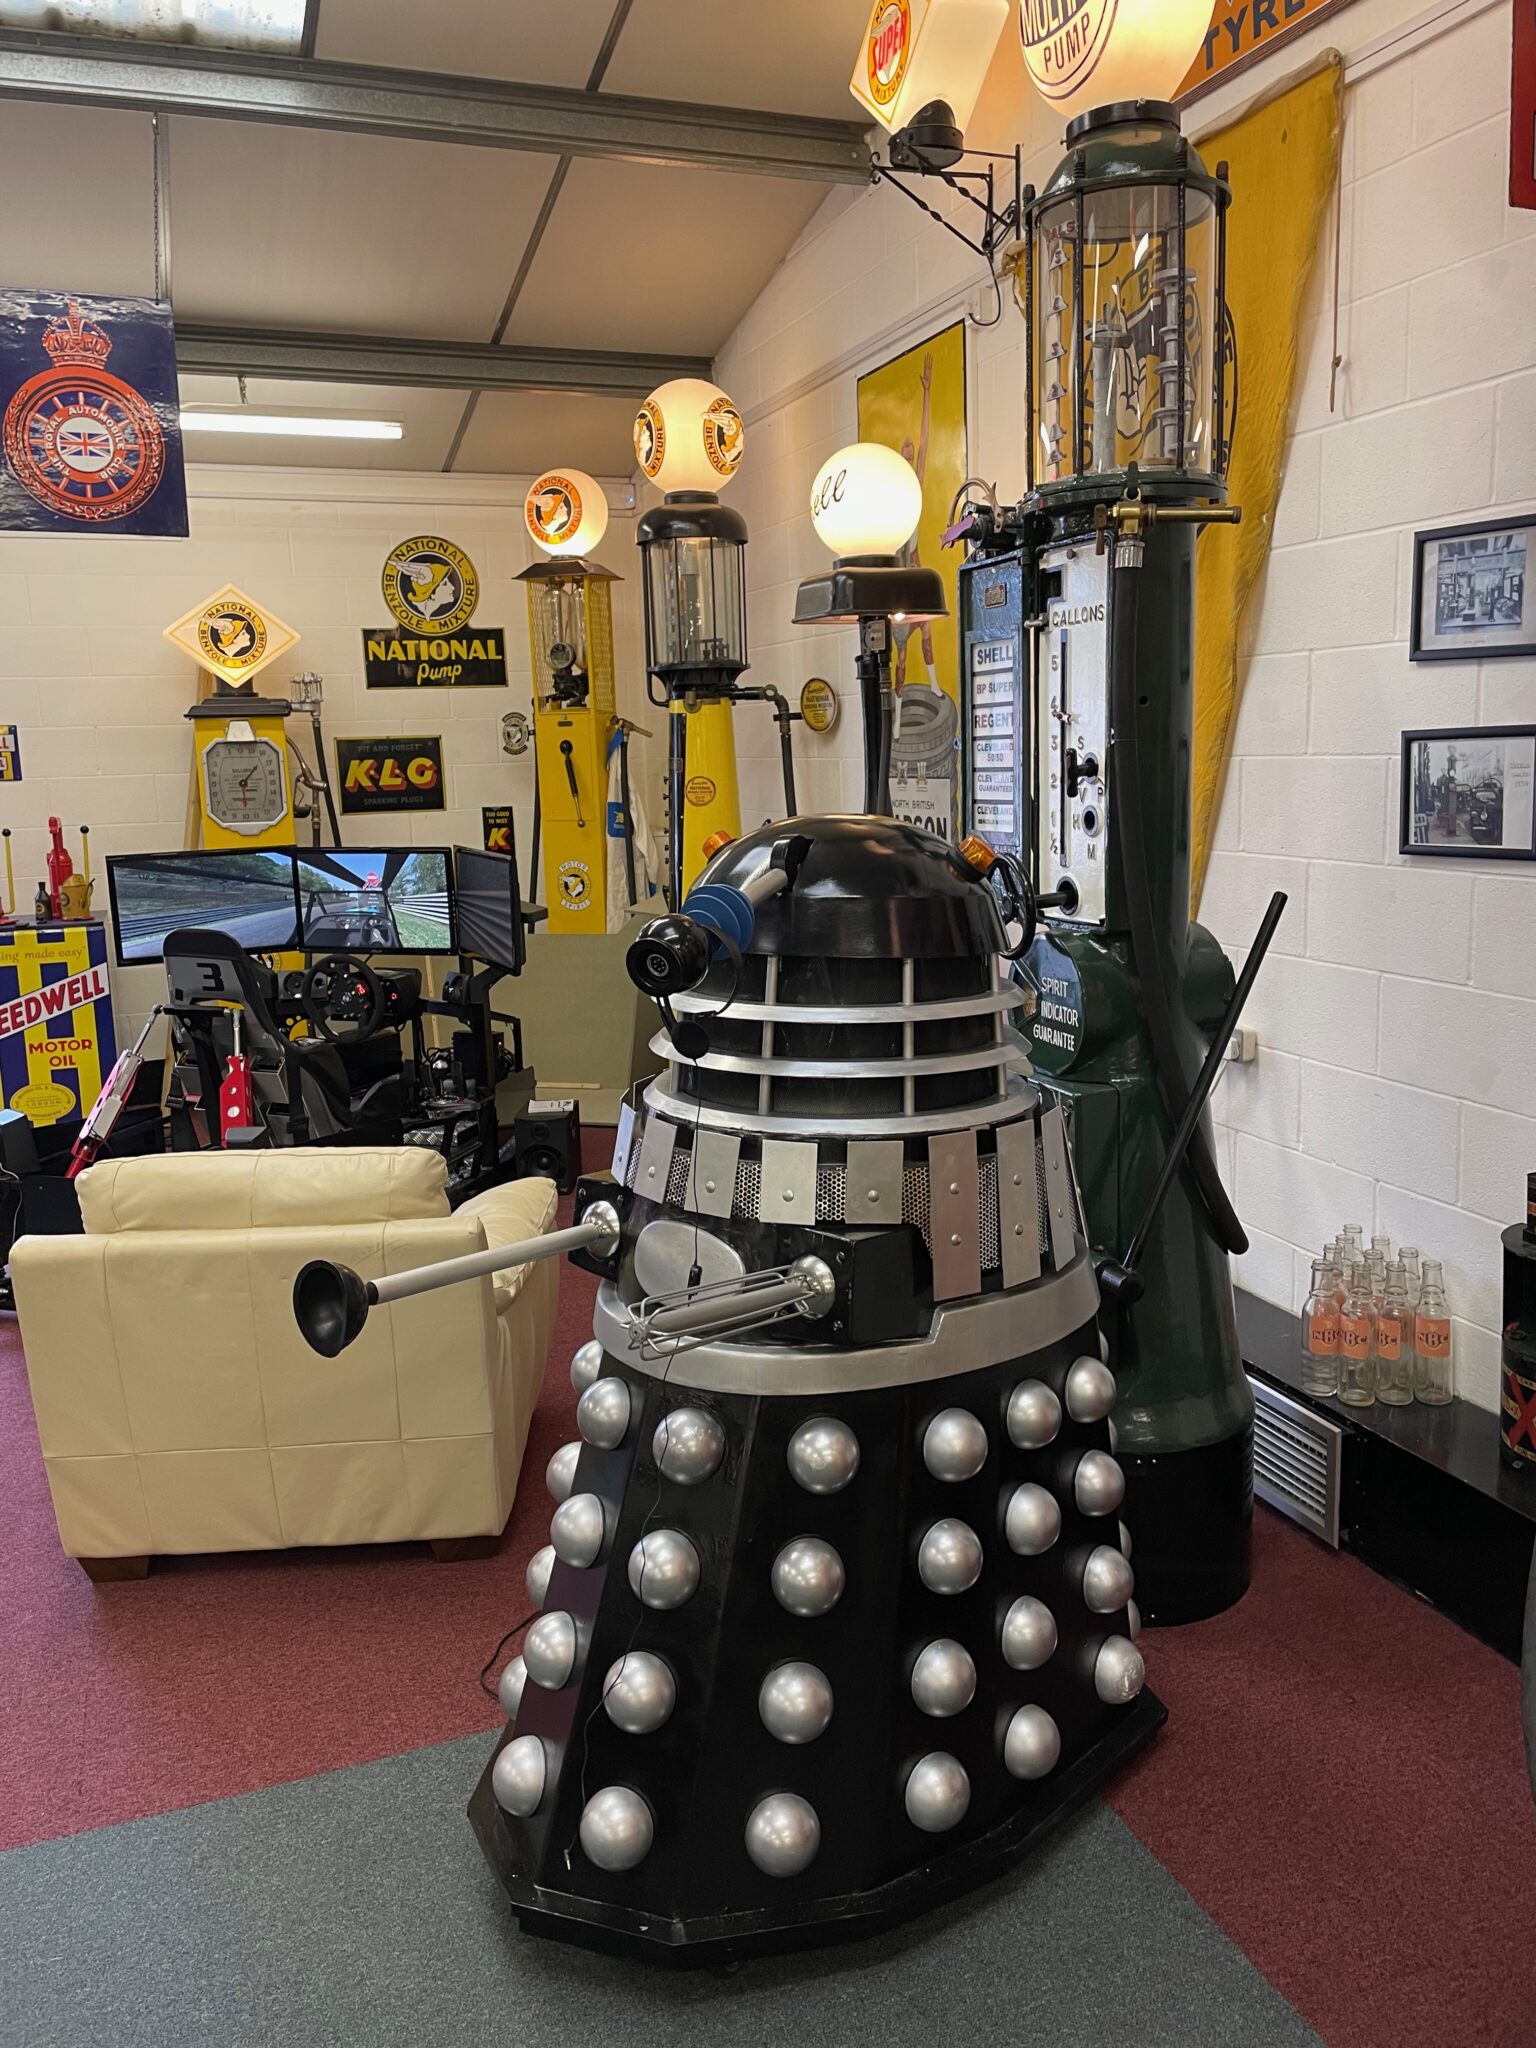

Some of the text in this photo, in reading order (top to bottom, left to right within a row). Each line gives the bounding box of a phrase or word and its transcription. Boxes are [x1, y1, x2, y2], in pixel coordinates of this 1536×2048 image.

[871, 9, 907, 79] SUPER
[1043, 12, 1090, 73] PUMP
[45, 406, 124, 479] THE ROYAL AUTOMOBILE CLUB
[650, 425, 664, 471] MIXTURE
[705, 426, 726, 471] BENZOLE
[533, 477, 573, 495] NATIONAL
[394, 539, 465, 568] NATIONAL
[385, 573, 475, 631] BENZOLE MIXTURE
[207, 604, 257, 621] NATIONAL
[1052, 604, 1105, 627] GALLONS
[201, 630, 265, 665] BENZOLE MIXTURE
[367, 639, 502, 661] NATIONAL
[977, 645, 1012, 665] SHELL
[1051, 654, 1059, 671] 5
[976, 681, 1014, 694] BP SUPER
[1050, 695, 1058, 713] 4
[974, 712, 1014, 729] REGENT
[977, 742, 1014, 751] CLEVELAND
[1050, 735, 1058, 751] 3
[1077, 736, 1085, 750] S
[977, 774, 1014, 783] CLEVELAND
[1050, 773, 1058, 789] 2
[400, 795, 424, 804] PLUGS
[912, 800, 935, 810] BRITISH
[977, 806, 1013, 815] CLEVELAND
[1072, 813, 1081, 830] H
[488, 827, 511, 850] K
[1087, 843, 1097, 860] M
[25, 947, 55, 959] made
[196, 962, 225, 992] 3
[1041, 976, 1068, 998] SPIRIT
[1040, 1001, 1079, 1027] INDICATOR
[29, 1039, 93, 1054] MOTOR
[1033, 1024, 1075, 1051] GUARANTEE
[49, 1055, 76, 1067] OIL
[1377, 1330, 1398, 1346] BC
[1418, 1331, 1449, 1349] NBC
